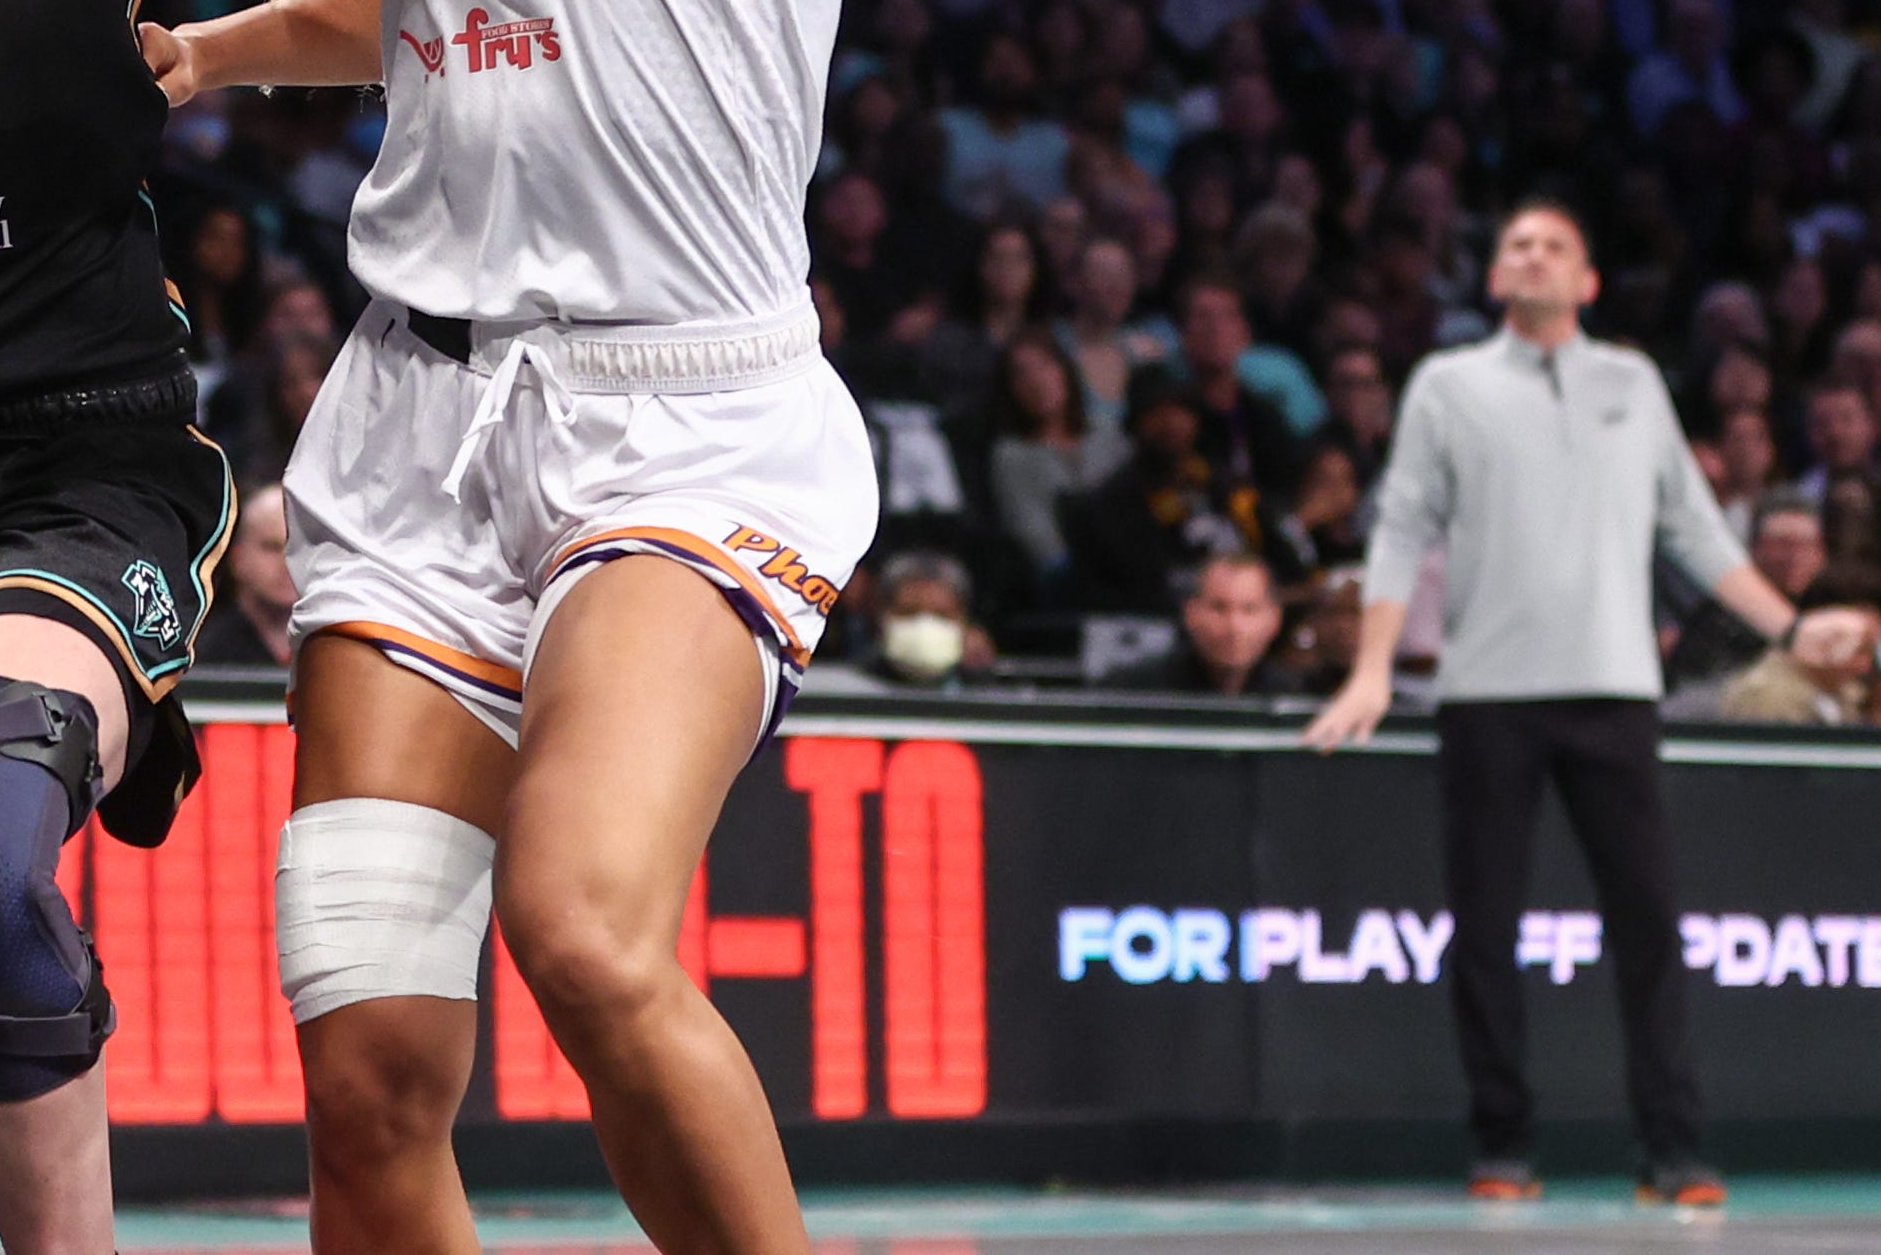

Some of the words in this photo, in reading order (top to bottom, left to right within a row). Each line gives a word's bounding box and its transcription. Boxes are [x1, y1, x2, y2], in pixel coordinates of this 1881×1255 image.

[451, 6, 561, 73] fry's
[1058, 904, 1232, 984] FOR
[1238, 907, 1604, 986] PLAYFF
[1677, 912, 1881, 988] PDATE
